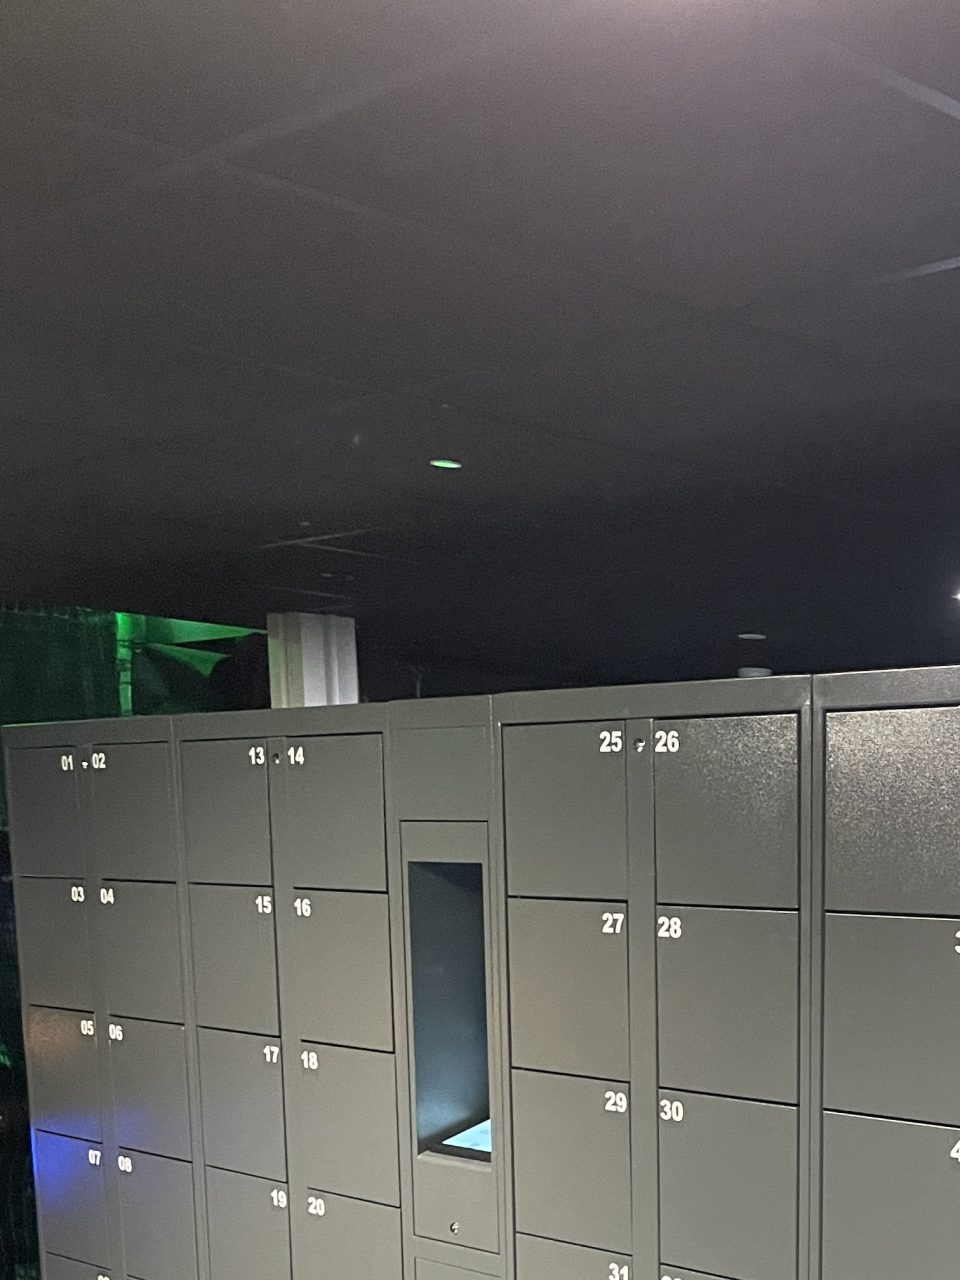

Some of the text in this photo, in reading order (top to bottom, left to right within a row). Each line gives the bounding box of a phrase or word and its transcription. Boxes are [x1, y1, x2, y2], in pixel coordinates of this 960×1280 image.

[599, 730, 623, 753] 25
[654, 730, 680, 753] 26
[61, 754, 74, 771] 01
[91, 752, 106, 769] 02
[248, 746, 265, 765] 13
[287, 746, 305, 765] 14
[71, 886, 85, 902] 03
[100, 888, 115, 904] 04
[255, 895, 272, 914] 15
[293, 898, 311, 917] 16
[601, 912, 625, 934] 27
[657, 916, 682, 939] 28
[80, 1019, 95, 1036] 05
[108, 1023, 123, 1041] 06
[263, 1045, 280, 1064] 17
[300, 1050, 319, 1070] 18
[604, 1090, 628, 1113] 29
[659, 1099, 684, 1122] 30
[88, 1149, 102, 1166] 07
[117, 1155, 133, 1173] 08
[270, 1188, 288, 1208] 19
[307, 1196, 326, 1216] 20
